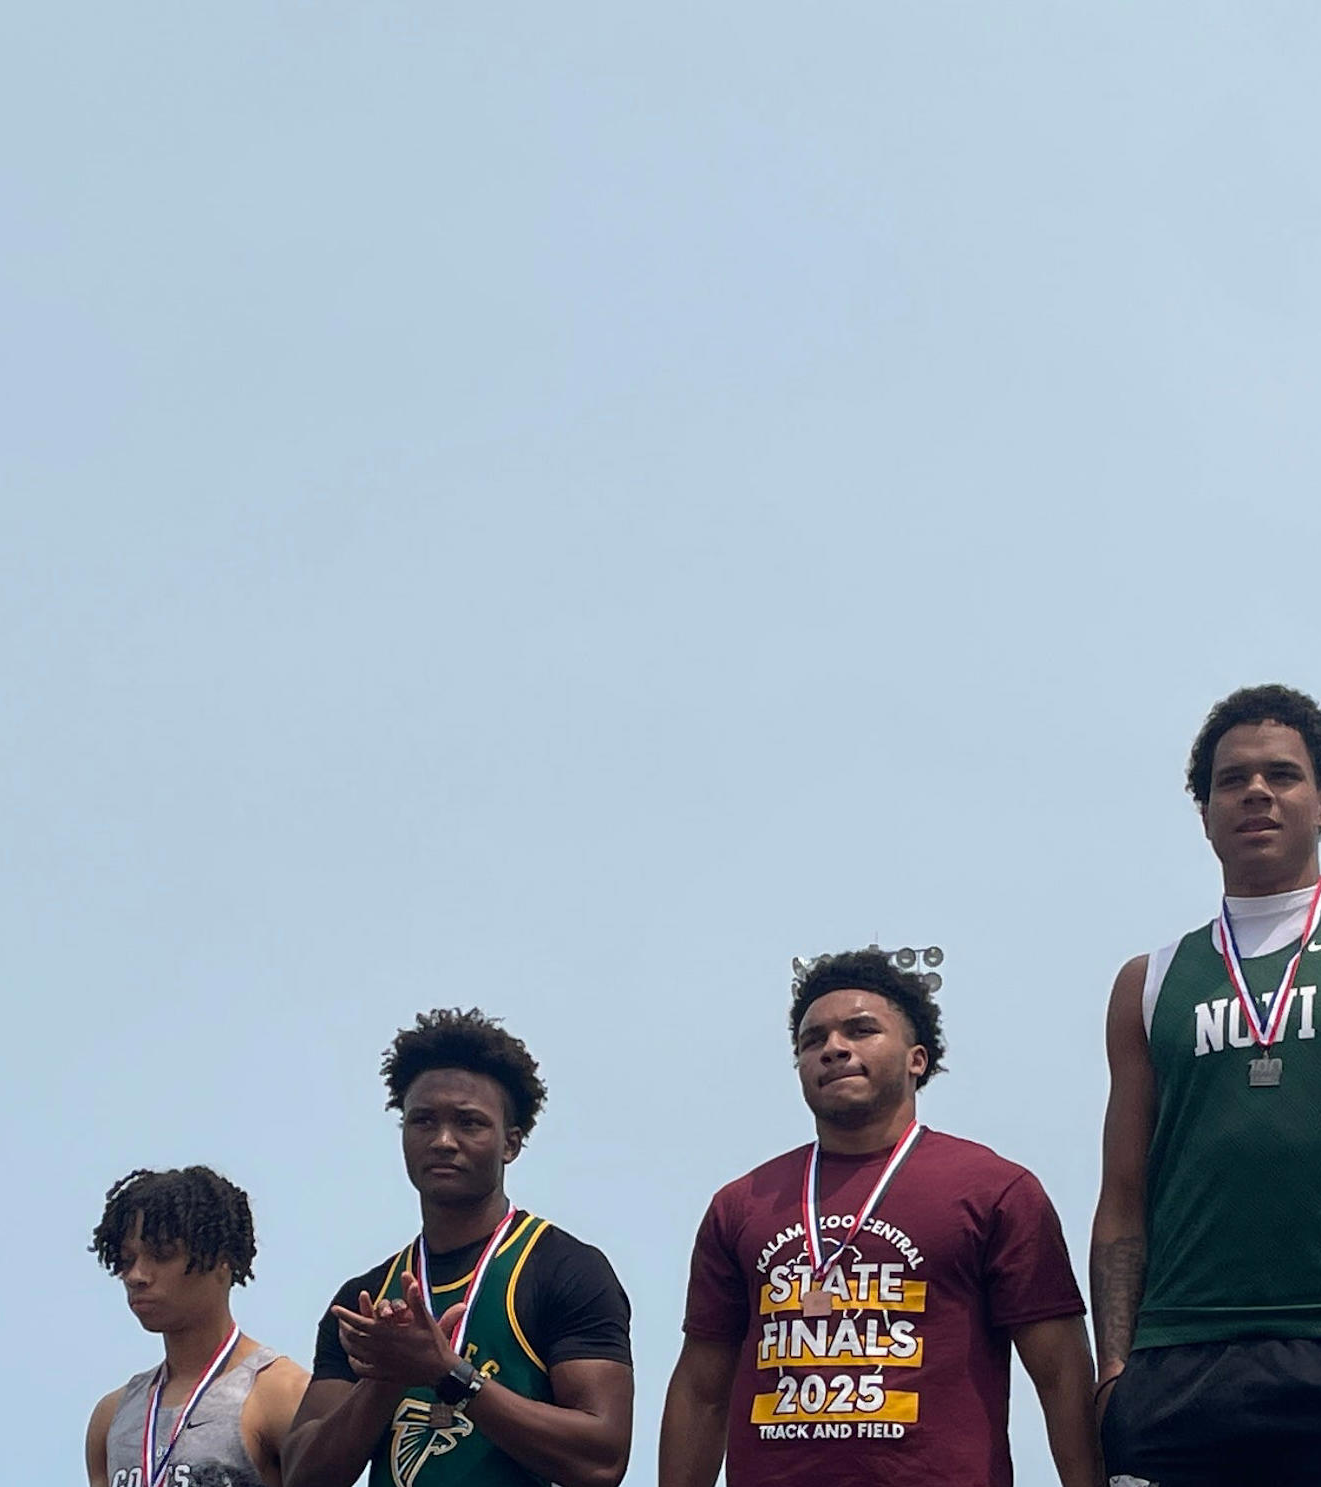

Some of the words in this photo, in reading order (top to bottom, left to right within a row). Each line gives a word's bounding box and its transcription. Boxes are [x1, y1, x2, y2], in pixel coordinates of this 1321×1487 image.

[756, 1215, 856, 1274] KALAMZOO
[769, 1263, 905, 1303] STATE
[762, 1319, 917, 1360] FINALS
[776, 1374, 885, 1414] 2025
[759, 1424, 809, 1440] TRACK
[812, 1423, 853, 1439] AND
[857, 1422, 906, 1438] FIELD
